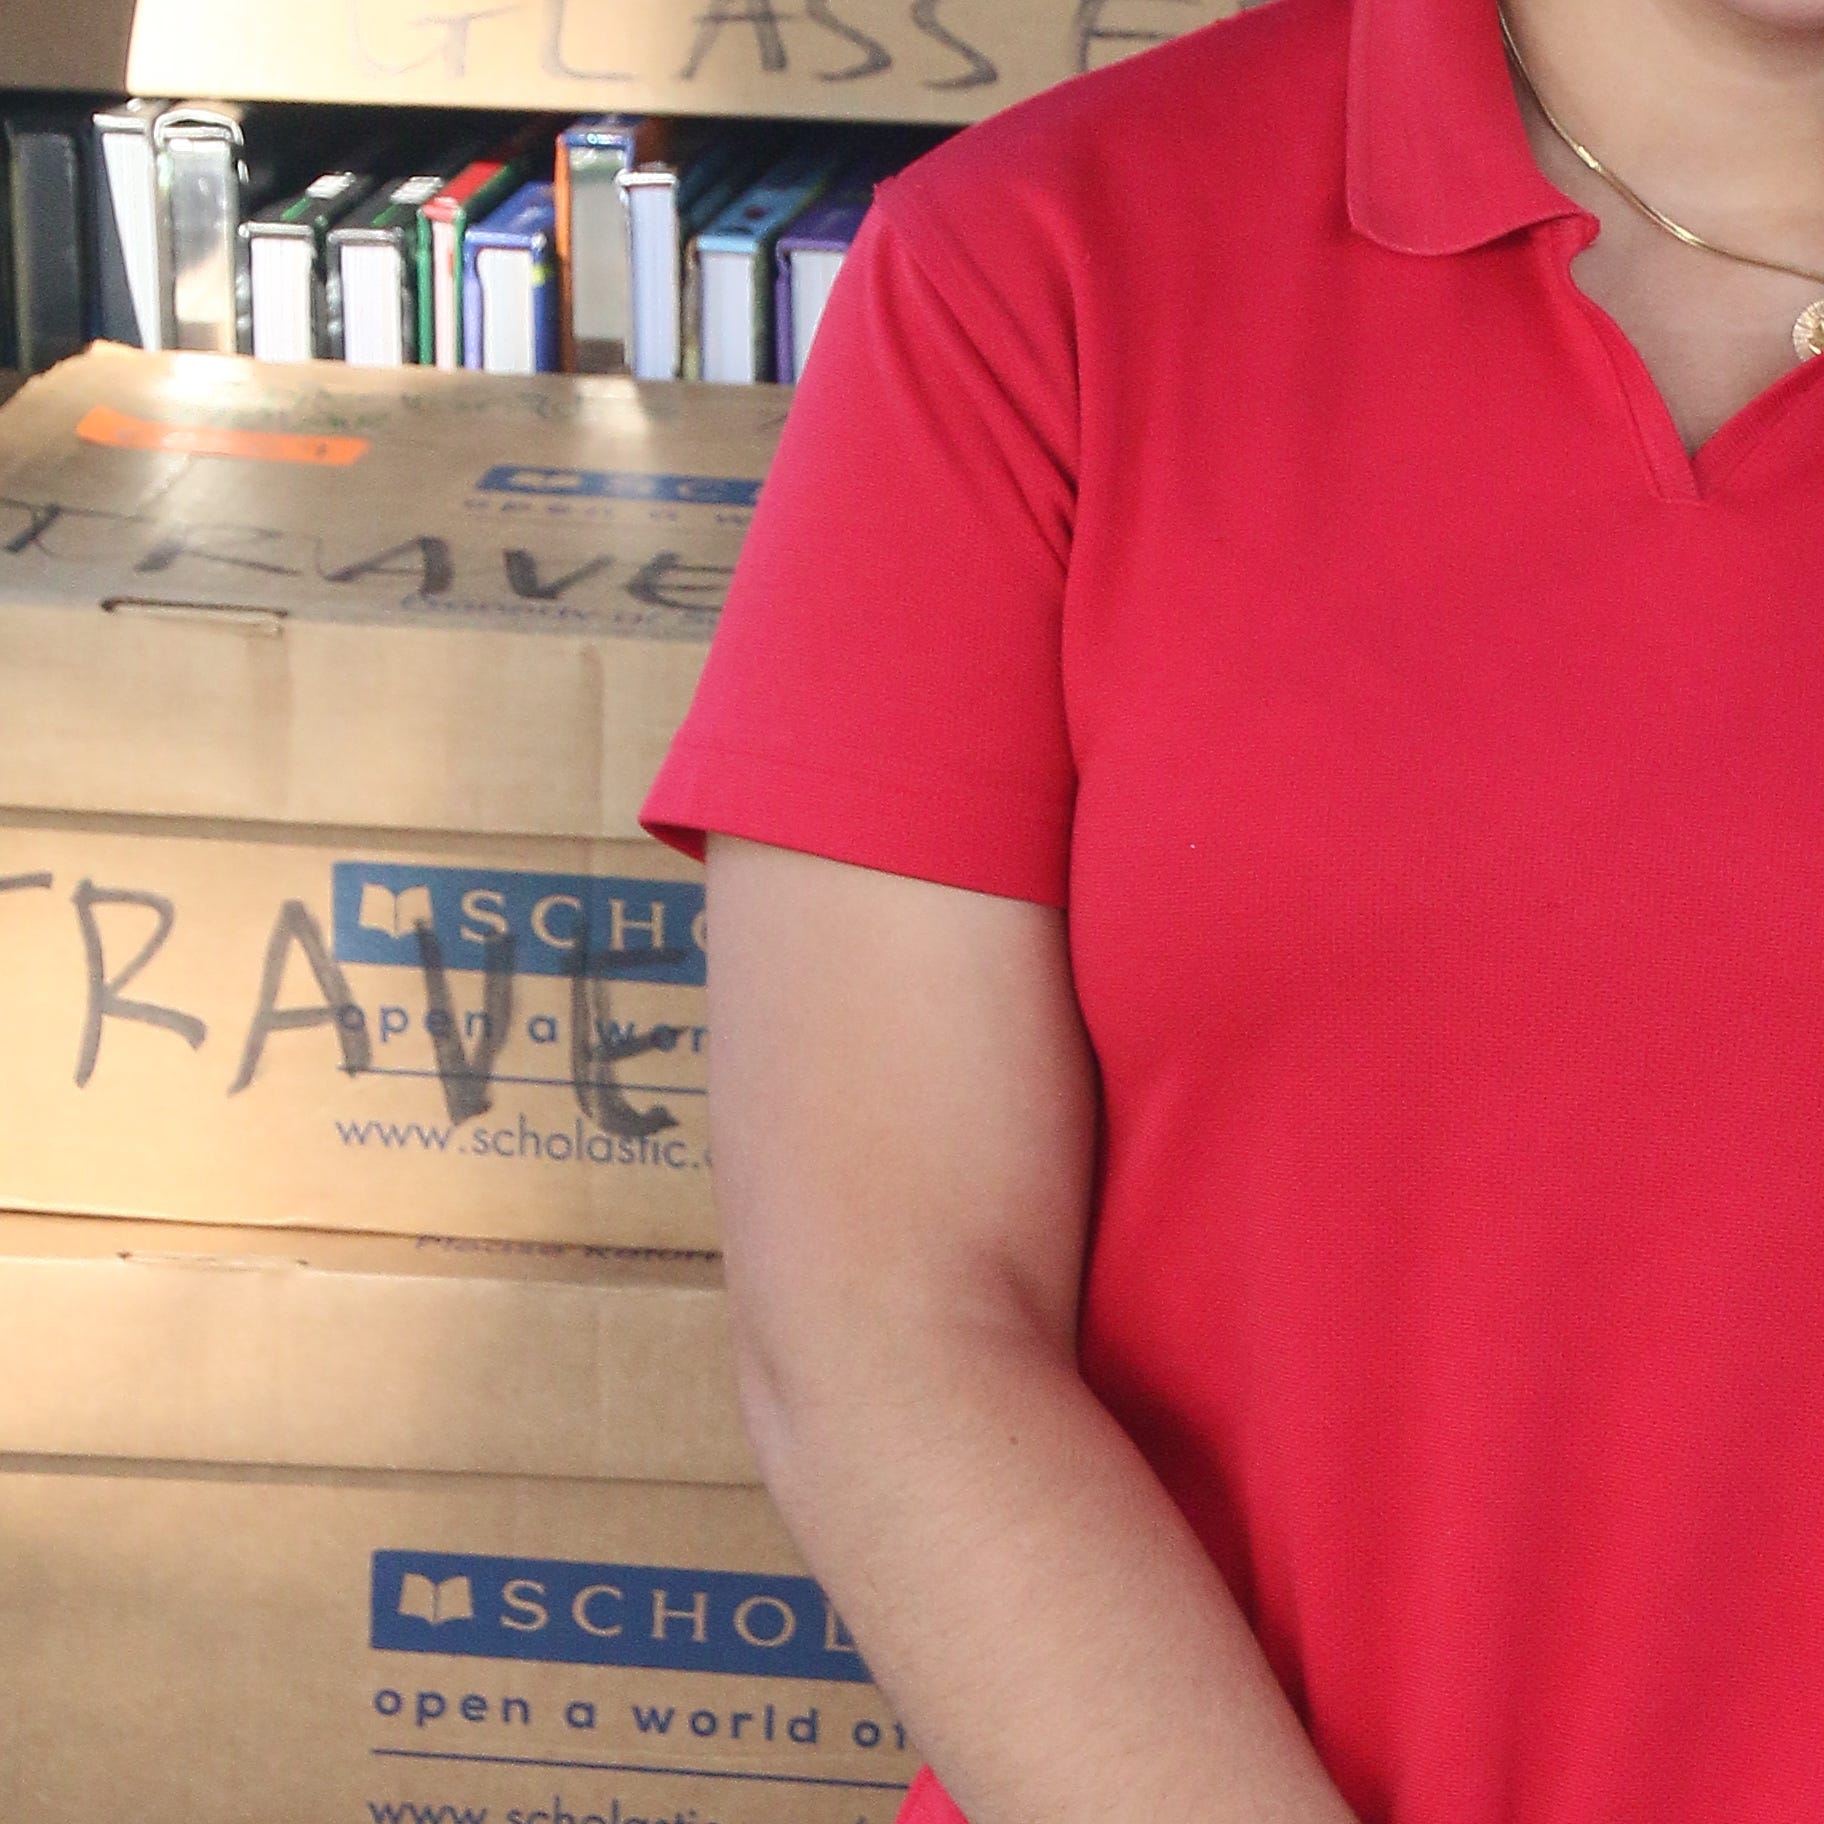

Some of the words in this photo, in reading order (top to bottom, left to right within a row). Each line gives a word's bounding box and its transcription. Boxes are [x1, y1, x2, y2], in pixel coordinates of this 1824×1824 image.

[459, 887, 707, 953] SCH
[335, 1003, 492, 1043] open
[527, 1014, 558, 1044] a
[334, 1112, 713, 1170] www.scholastic.
[374, 1688, 531, 1728] open
[565, 1700, 596, 1729] a
[631, 1702, 820, 1745] world
